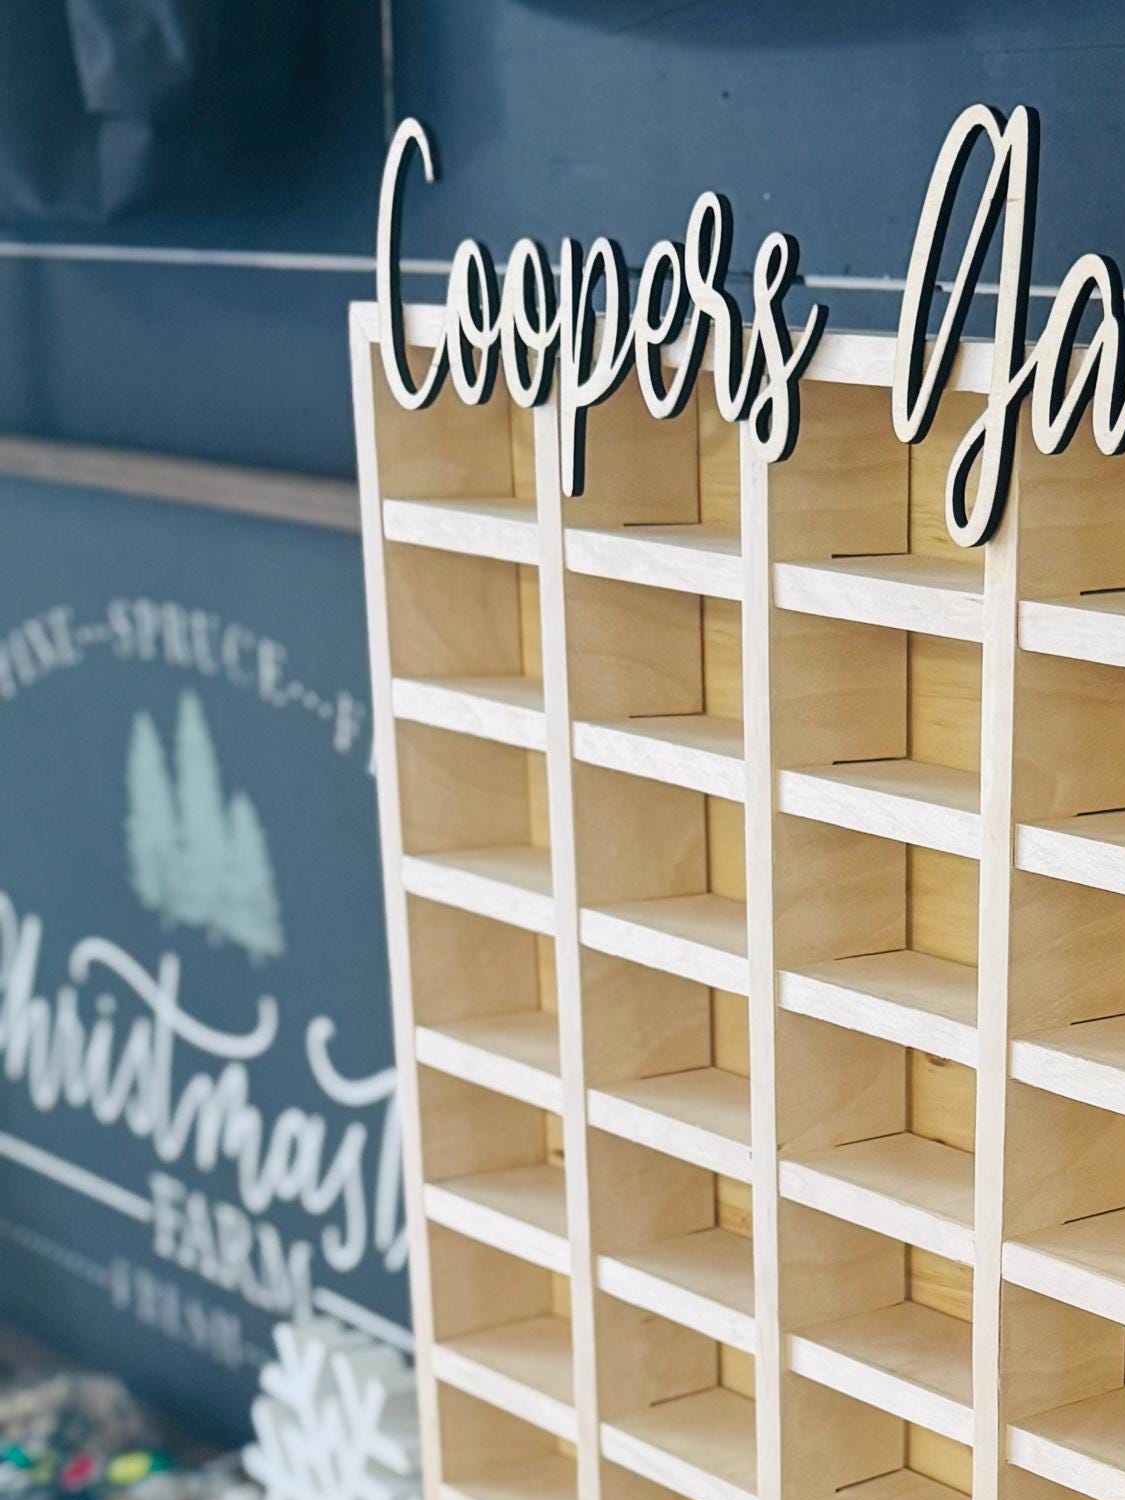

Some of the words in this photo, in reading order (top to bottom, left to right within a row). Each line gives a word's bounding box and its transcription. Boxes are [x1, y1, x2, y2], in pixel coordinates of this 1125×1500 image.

[377, 117, 825, 498] Coopers
[0, 604, 83, 699] INE
[107, 597, 287, 708] SPRUCE
[148, 1170, 314, 1322] FARM
